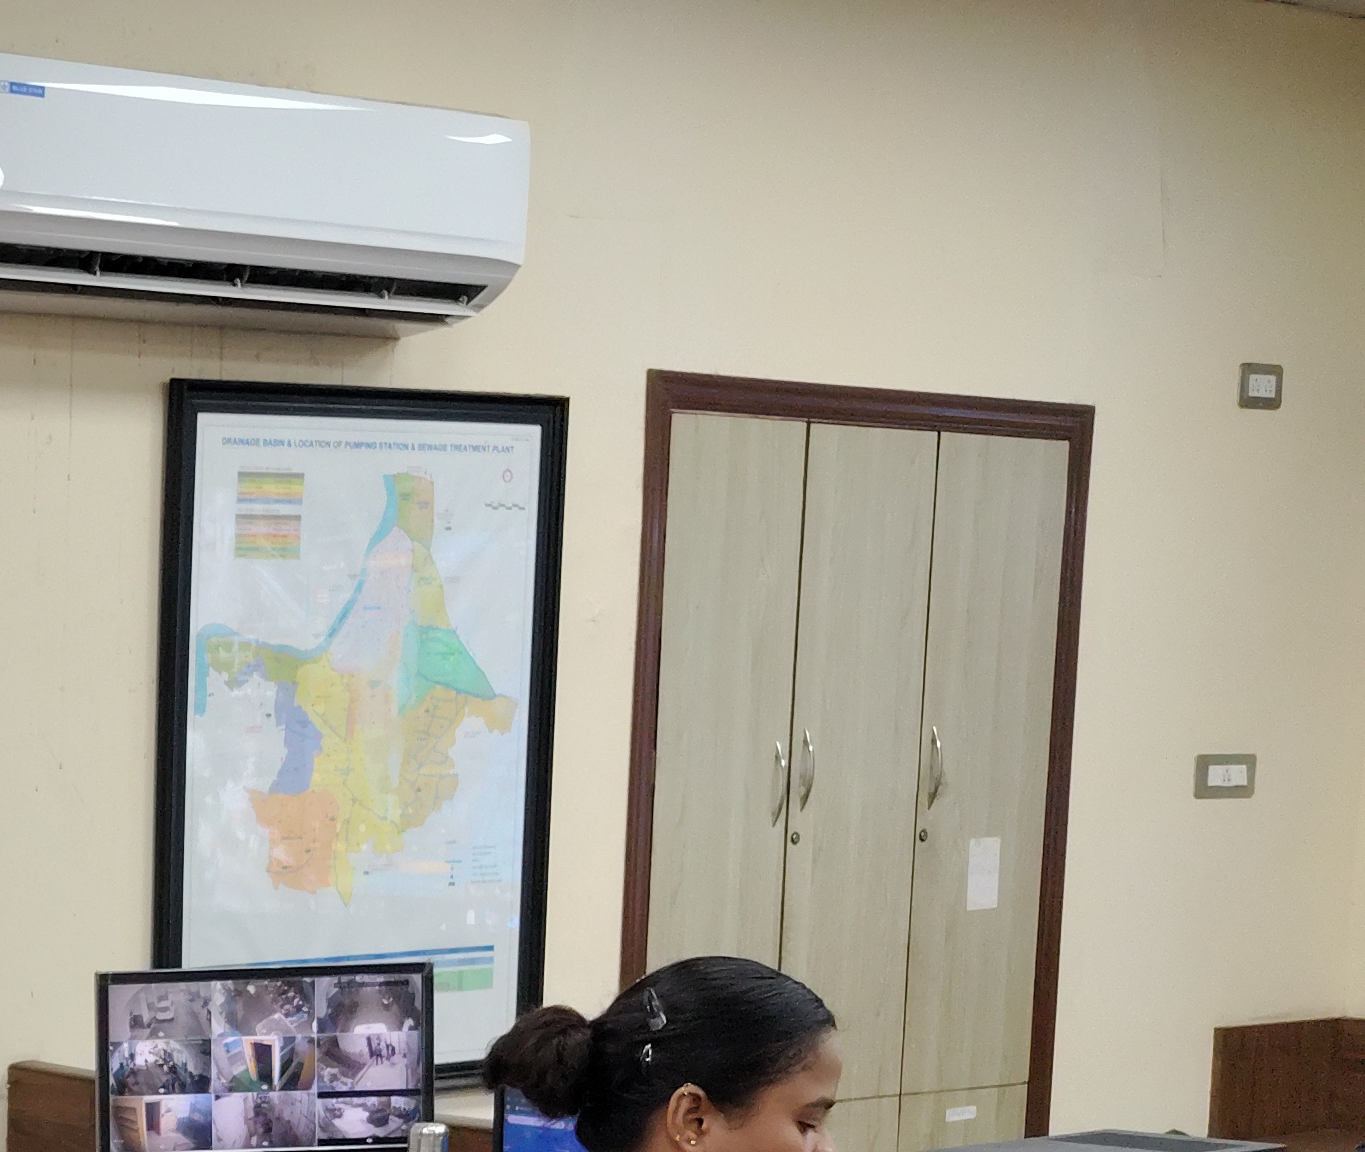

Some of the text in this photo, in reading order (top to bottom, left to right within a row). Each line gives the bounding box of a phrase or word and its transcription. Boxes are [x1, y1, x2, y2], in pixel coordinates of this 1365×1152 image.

[294, 439, 331, 449] LOCATION
[333, 440, 342, 449] OF
[379, 441, 409, 451] STATION
[492, 444, 515, 454] PLANT
